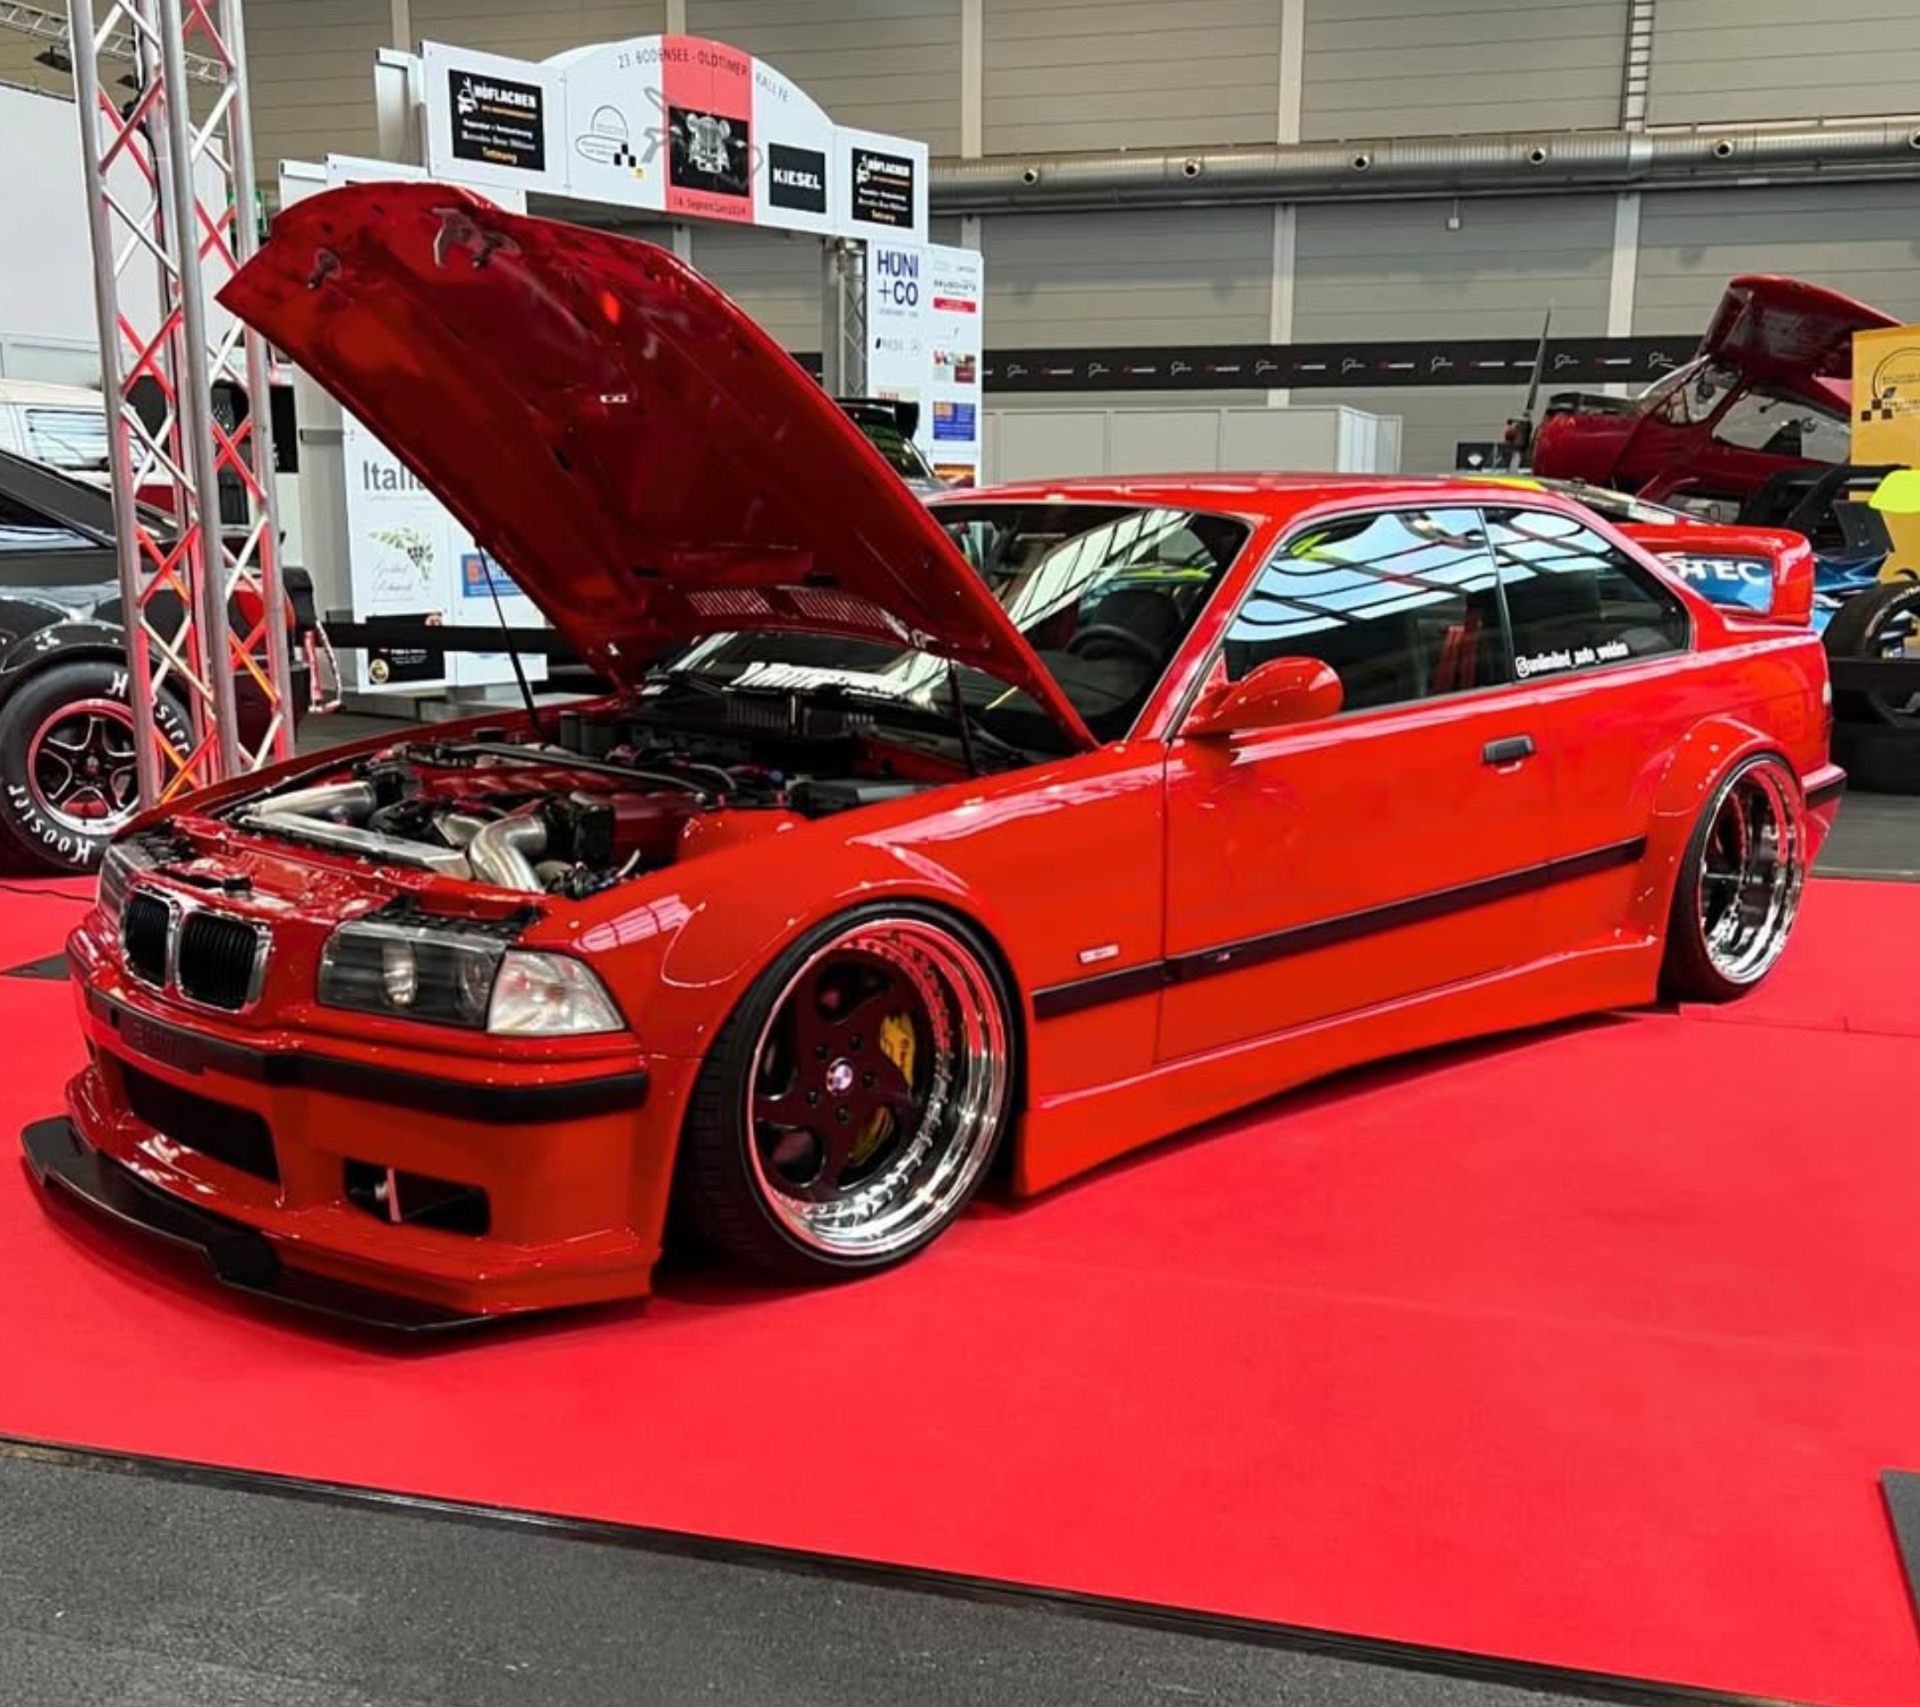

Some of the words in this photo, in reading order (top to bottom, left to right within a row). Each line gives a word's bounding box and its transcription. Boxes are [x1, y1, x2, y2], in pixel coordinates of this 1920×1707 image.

[636, 48, 689, 65] BODENSEE
[699, 50, 748, 76] OLDTIMER
[772, 167, 822, 190] KIESEL
[8, 784, 97, 864] Hoosier
